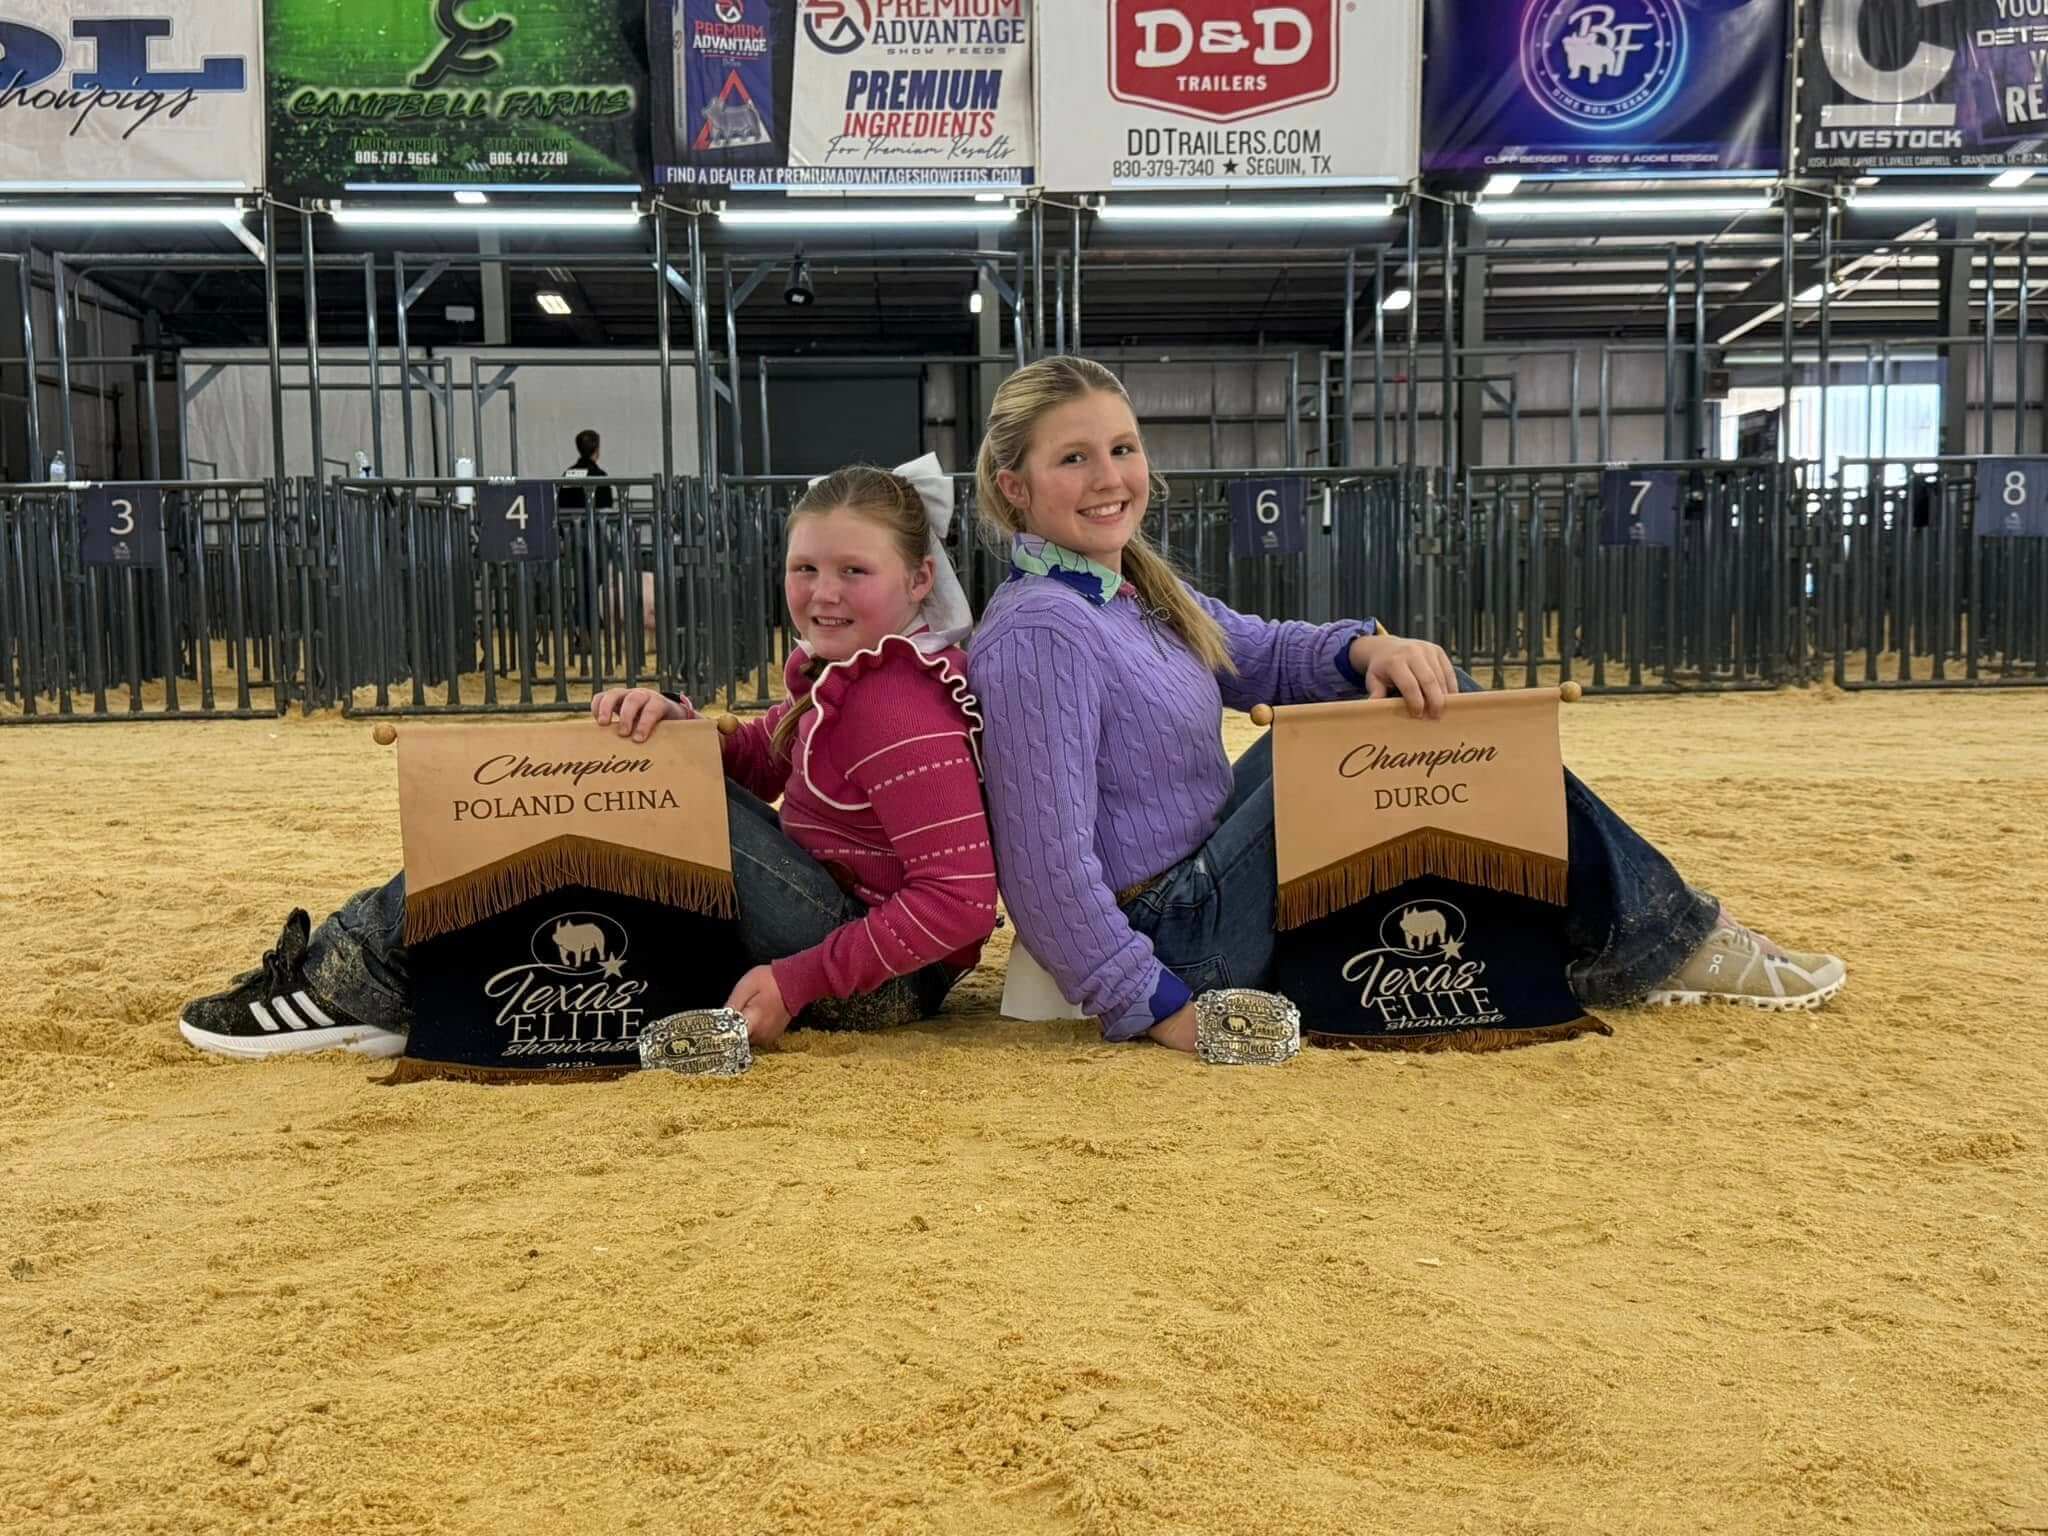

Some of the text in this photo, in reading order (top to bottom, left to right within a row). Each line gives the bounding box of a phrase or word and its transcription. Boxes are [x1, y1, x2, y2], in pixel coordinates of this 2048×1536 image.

[876, 0, 1022, 17] PREMIUM
[693, 34, 767, 52] ADVANTAGE
[695, 21, 764, 38] PREMIUM
[872, 19, 1026, 44] ADVANTAGE
[1135, 8, 1312, 67] D&D
[947, 47, 1007, 55] FEEDS
[845, 70, 1002, 110] PREMIUM
[1177, 75, 1267, 91] TRAILERS
[288, 86, 633, 119] CAMPBELL FARMS
[843, 111, 995, 138] INGREDIENTS
[1815, 130, 1961, 149] LIVESTOCK
[355, 152, 438, 165] 806.787.9664
[824, 136, 860, 163] For
[667, 167, 1022, 185] FIND A DEALER AT PREMIUMADVANTAGESHOWFEEDS.COM
[1113, 159, 1214, 177] 830-379-7340
[1311, 156, 1331, 174] TX
[1630, 481, 1653, 515] 7
[2003, 470, 2026, 505] 8
[110, 499, 134, 535] 3
[505, 495, 529, 529] 4
[1256, 489, 1280, 524] 6
[473, 753, 653, 786] Champion
[1338, 741, 1499, 778] Champion
[453, 788, 681, 821] POLAND CHINA
[1374, 783, 1470, 810] DUROC
[1342, 947, 1486, 1008] Texas
[484, 963, 649, 1026] Texas
[1373, 987, 1499, 1022] ELITE
[508, 1008, 644, 1043] ELITE
